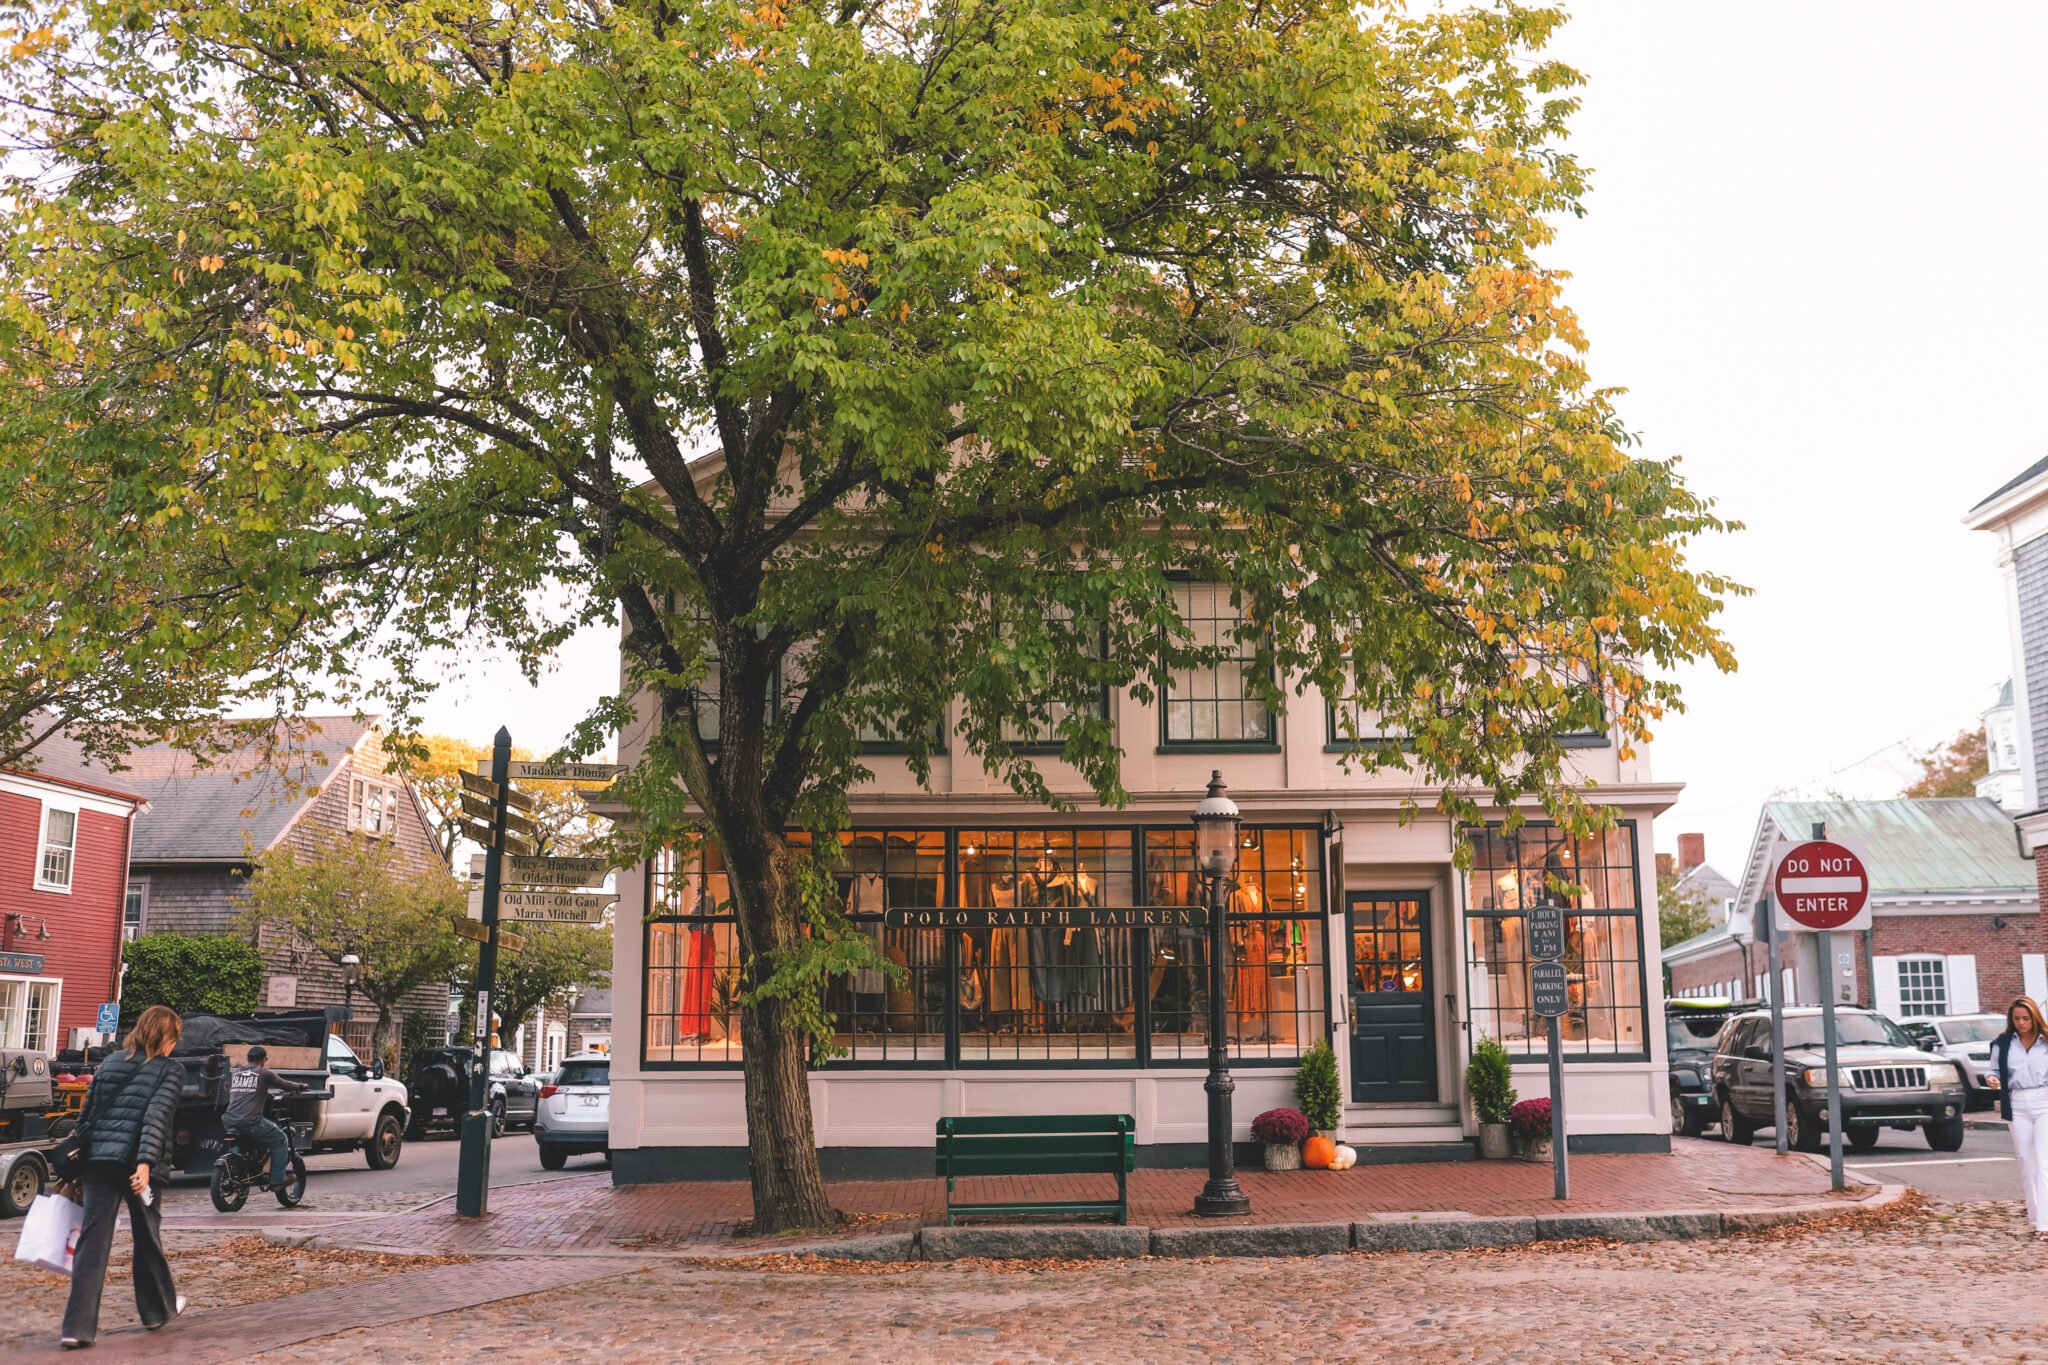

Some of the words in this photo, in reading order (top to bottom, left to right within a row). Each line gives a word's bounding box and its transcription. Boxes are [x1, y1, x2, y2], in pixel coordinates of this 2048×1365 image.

[520, 765, 567, 777] Madaket
[511, 859, 538, 872] Macy
[547, 860, 587, 872] Hadwen
[589, 861, 599, 872] &
[1787, 859, 1809, 873] DO
[1820, 858, 1852, 872] NOT
[522, 872, 553, 884] Oldest
[556, 873, 586, 885] House
[504, 894, 522, 905] Old
[525, 895, 545, 906] Mill
[554, 896, 572, 907] Old
[575, 896, 599, 908] Gaol
[1796, 898, 1848, 912] ENTER
[514, 908, 544, 919] Maria
[547, 909, 587, 921] Mitchell
[903, 911, 968, 925] POLO
[988, 911, 1070, 925] RALPH
[1090, 910, 1191, 924] LAUREN
[1531, 911, 1535, 919] 1
[1537, 910, 1556, 919] HOUR
[1530, 921, 1559, 929] PARKING
[1533, 930, 1538, 938] 8
[1541, 930, 1556, 938] AM
[1543, 944, 1556, 952] PM
[14, 958, 33, 968] WEST
[1533, 968, 1562, 978] PARALLEL
[1534, 982, 1563, 991] PARKING
[1537, 995, 1561, 1003] ONLY
